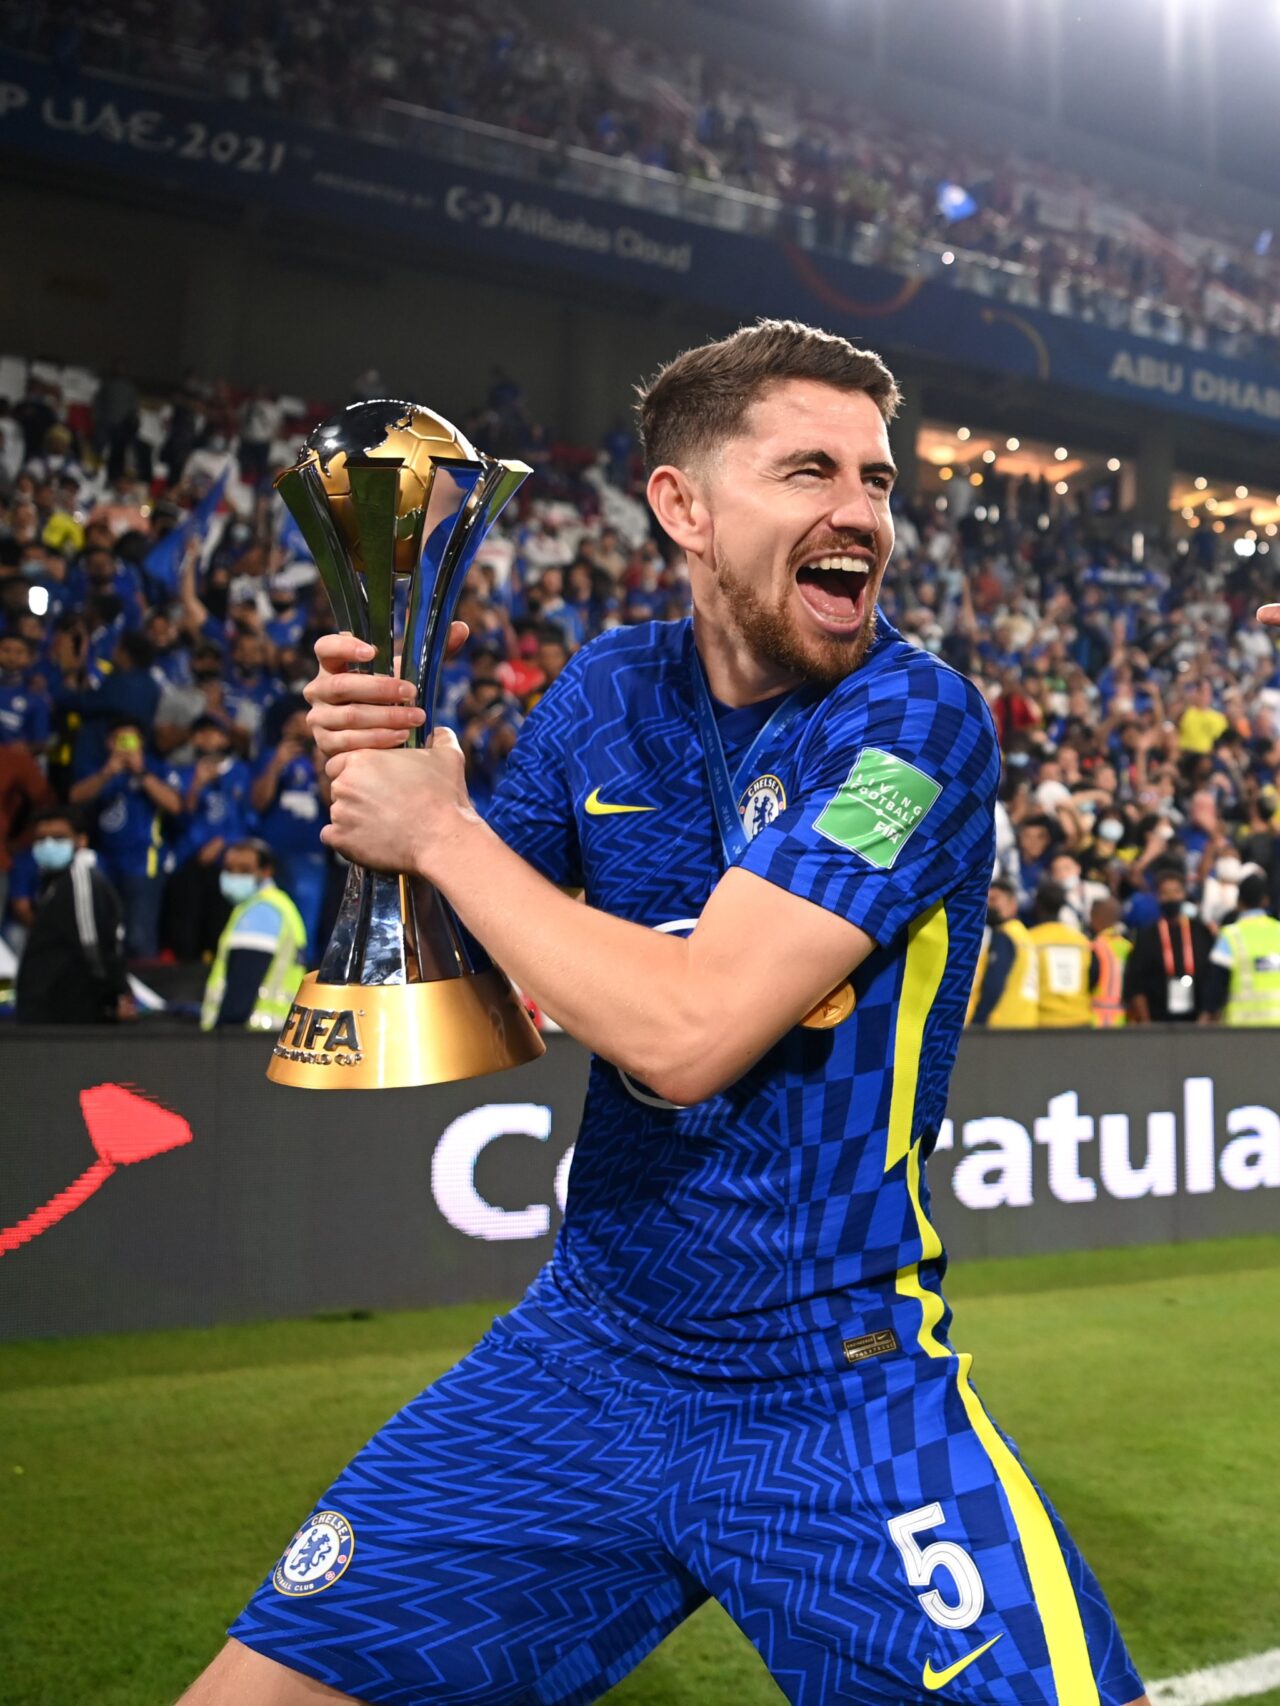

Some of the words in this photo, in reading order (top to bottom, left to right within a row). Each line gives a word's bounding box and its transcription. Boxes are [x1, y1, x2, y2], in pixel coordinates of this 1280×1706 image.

[41, 95, 176, 150] UAE
[180, 123, 286, 174] 2021
[615, 226, 692, 274] Cloud
[1108, 349, 1184, 394] ABU
[748, 778, 780, 797] CHELSEA
[850, 782, 915, 824] FOOTBALL
[856, 773, 922, 816] LIVING
[873, 820, 902, 845] FIFA
[280, 1004, 360, 1051] FIFA
[311, 1514, 351, 1543] CHELSEA
[887, 1501, 984, 1630] 5
[294, 1583, 315, 1592] CLUB
